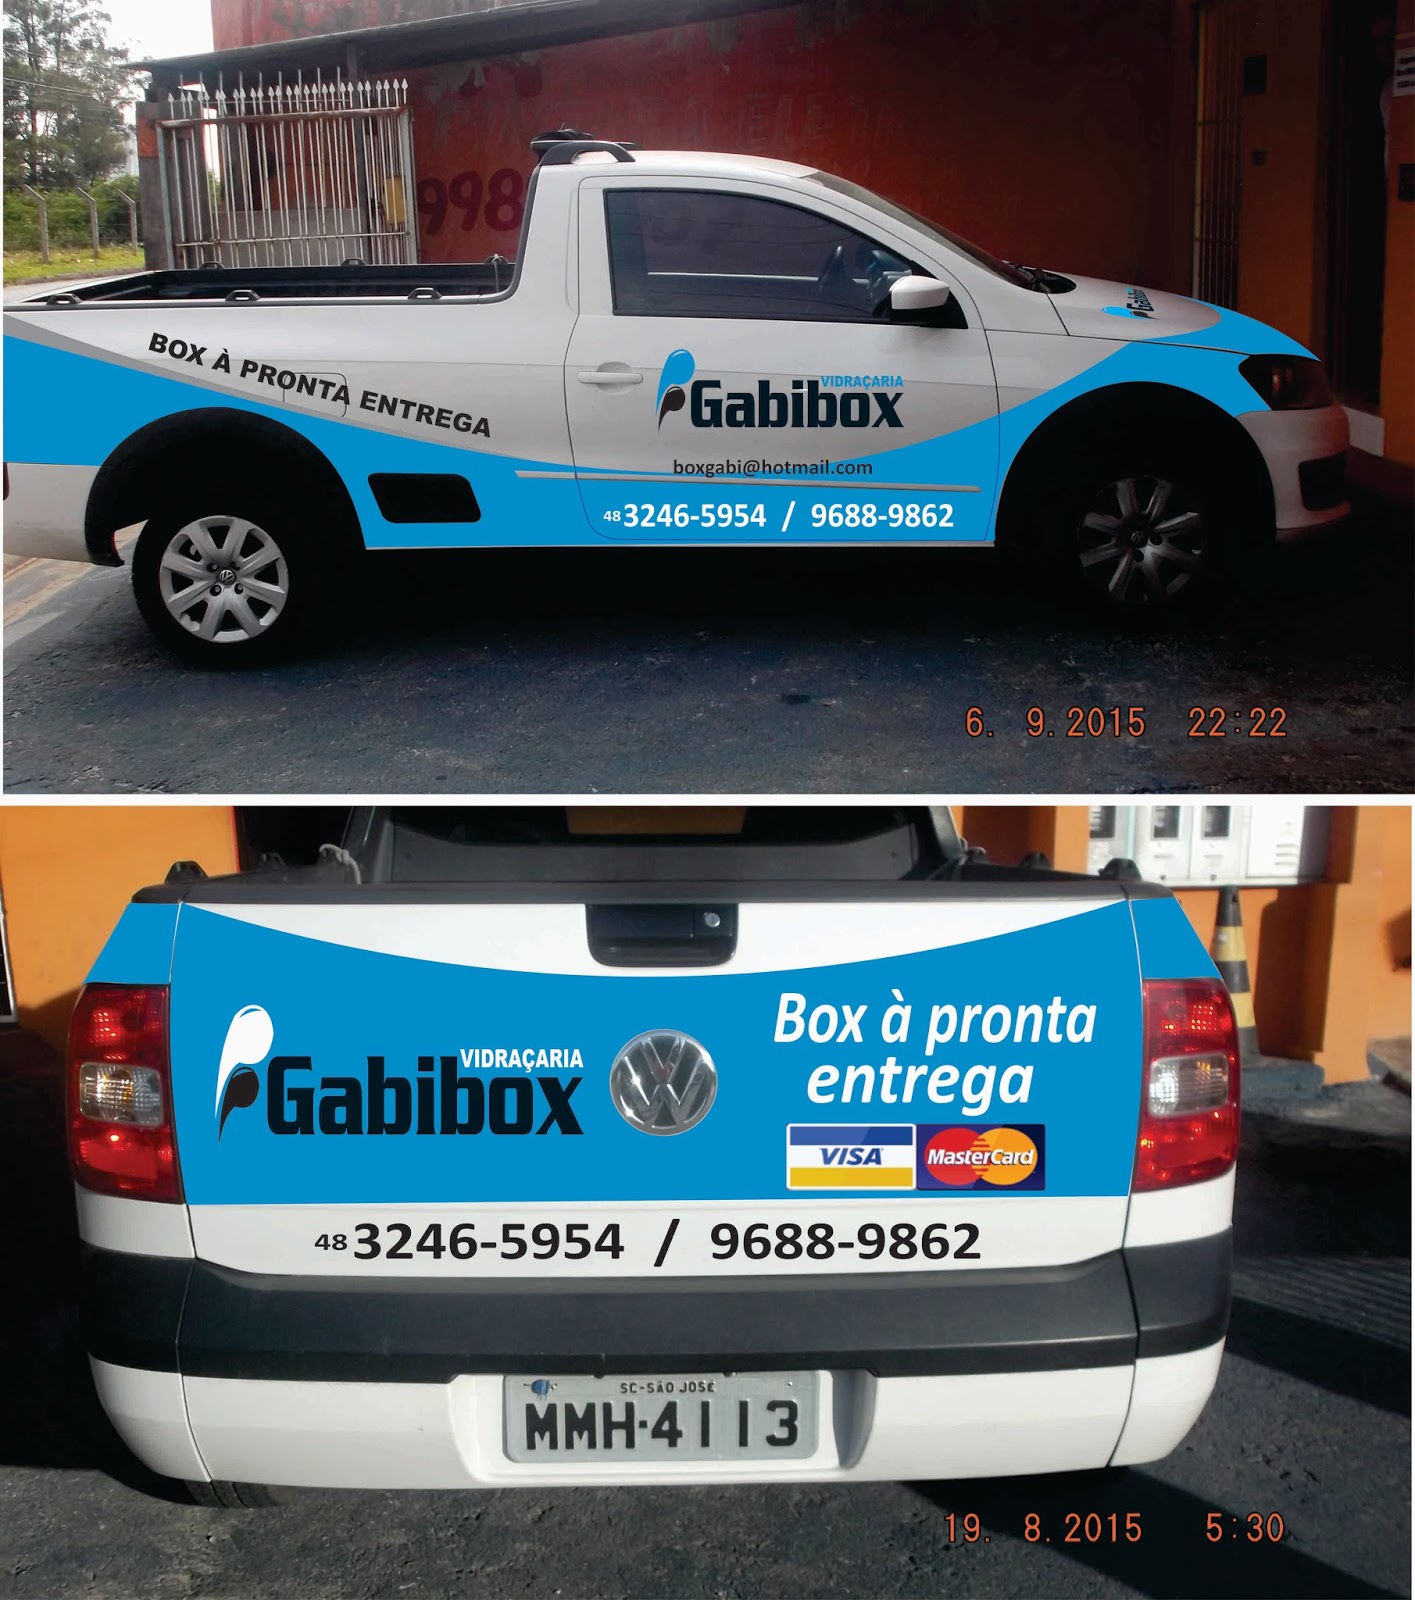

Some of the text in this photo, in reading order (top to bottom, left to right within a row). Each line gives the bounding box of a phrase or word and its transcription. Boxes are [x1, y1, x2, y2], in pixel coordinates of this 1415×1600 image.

[149, 332, 492, 438] BOX À PRONTA ENTREGA
[820, 375, 904, 389] VIDRAÇARIA
[690, 379, 904, 428] Gabibox
[673, 459, 873, 477] boxgabi@hotmail.com
[603, 510, 622, 523] 48
[623, 503, 767, 528] 3246-5954
[811, 503, 954, 528] 9688-9862
[774, 988, 1097, 1056] Box à pronta
[460, 1048, 584, 1073] VIDRAÇARIA
[267, 1056, 584, 1135] Gabibox
[807, 1056, 1034, 1117] entrega
[819, 1147, 883, 1166] VISA
[927, 1148, 1034, 1166] MasterCard
[314, 1234, 348, 1251] 48
[353, 1223, 625, 1260] 3246-5954
[710, 1223, 982, 1260] 9688-9862
[525, 1400, 799, 1450] MMH-4113
